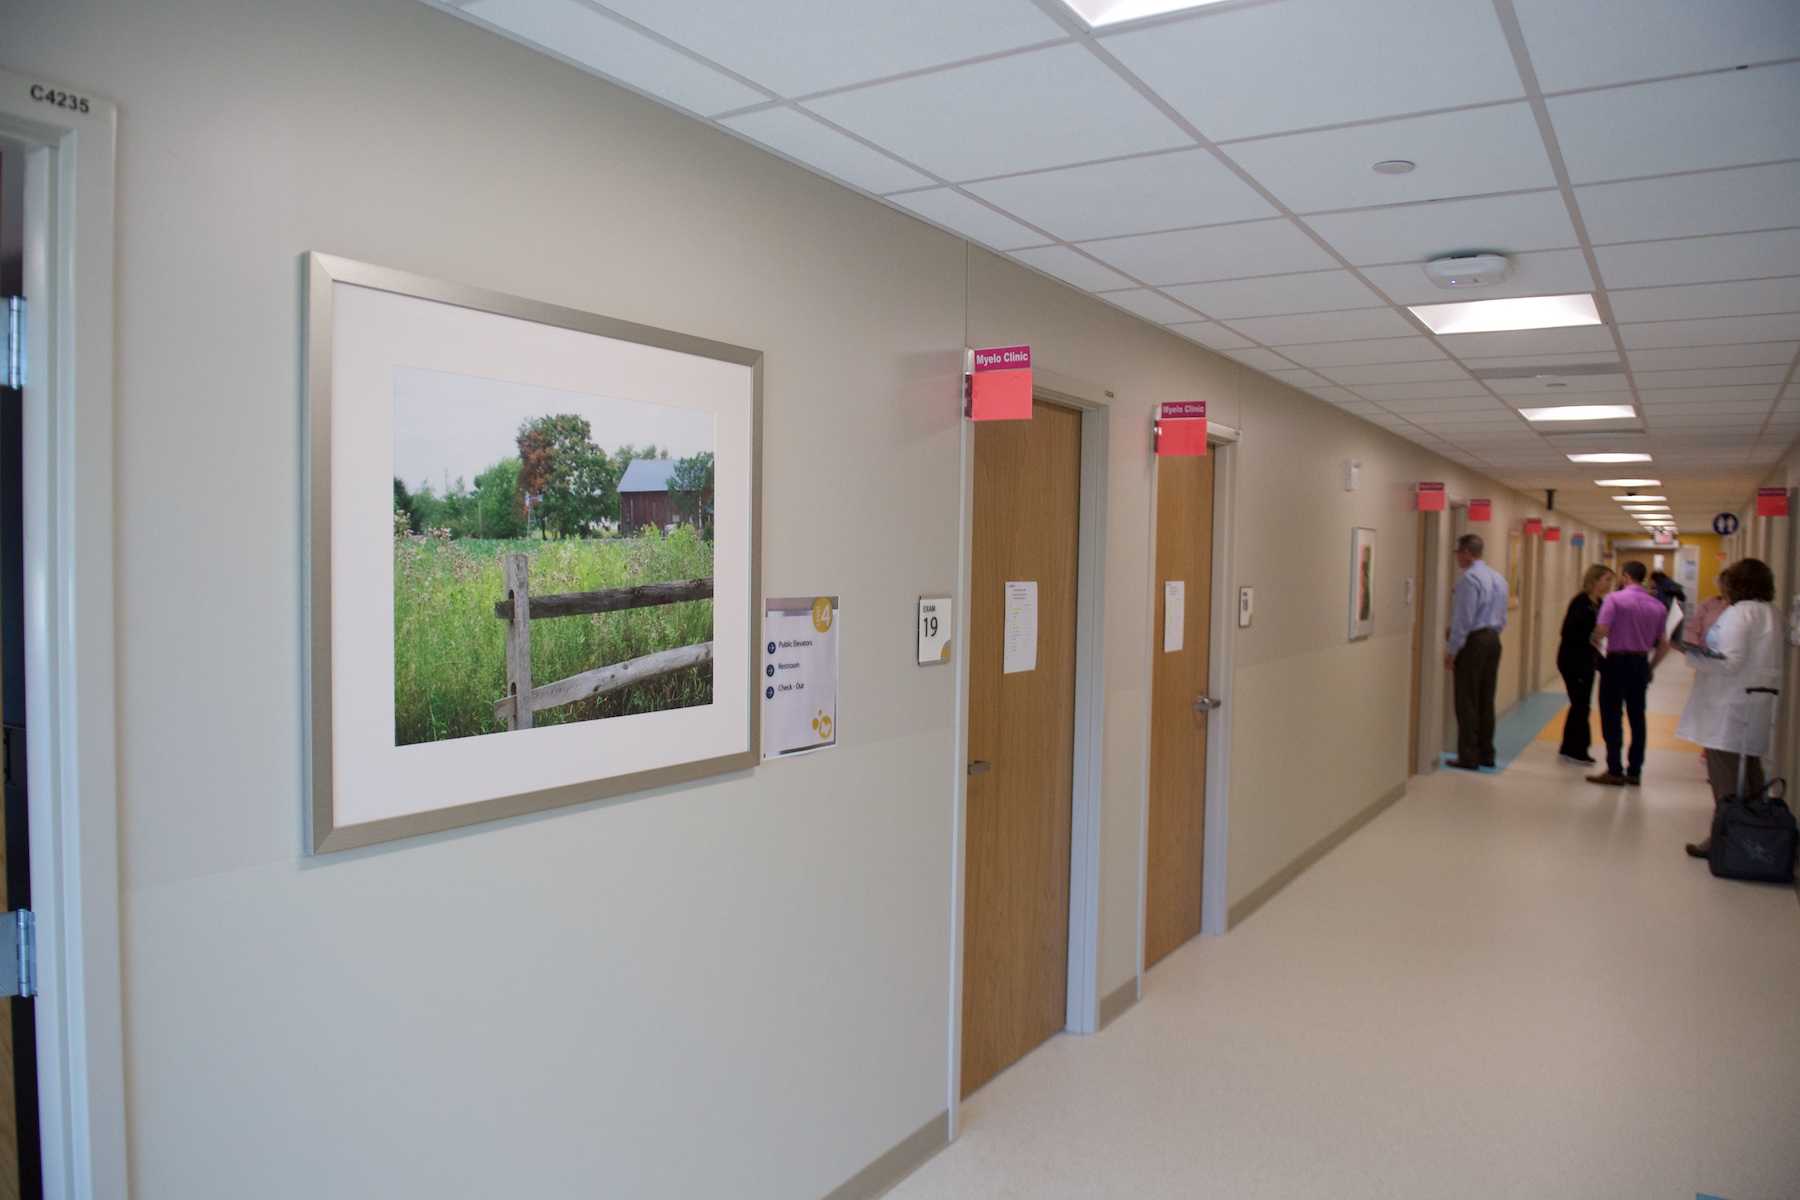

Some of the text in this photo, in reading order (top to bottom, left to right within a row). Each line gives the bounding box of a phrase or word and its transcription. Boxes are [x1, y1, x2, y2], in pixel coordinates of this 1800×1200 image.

[30, 84, 90, 114] C4235
[976, 351, 1029, 367] Myelo Clinic
[1162, 404, 1205, 415] Myelo Clinic
[821, 604, 832, 626] 4
[922, 605, 936, 613] EXAM
[923, 616, 938, 637] 19
[778, 662, 800, 670] Restroom
[778, 683, 793, 691] Check
[796, 682, 804, 690] Out
